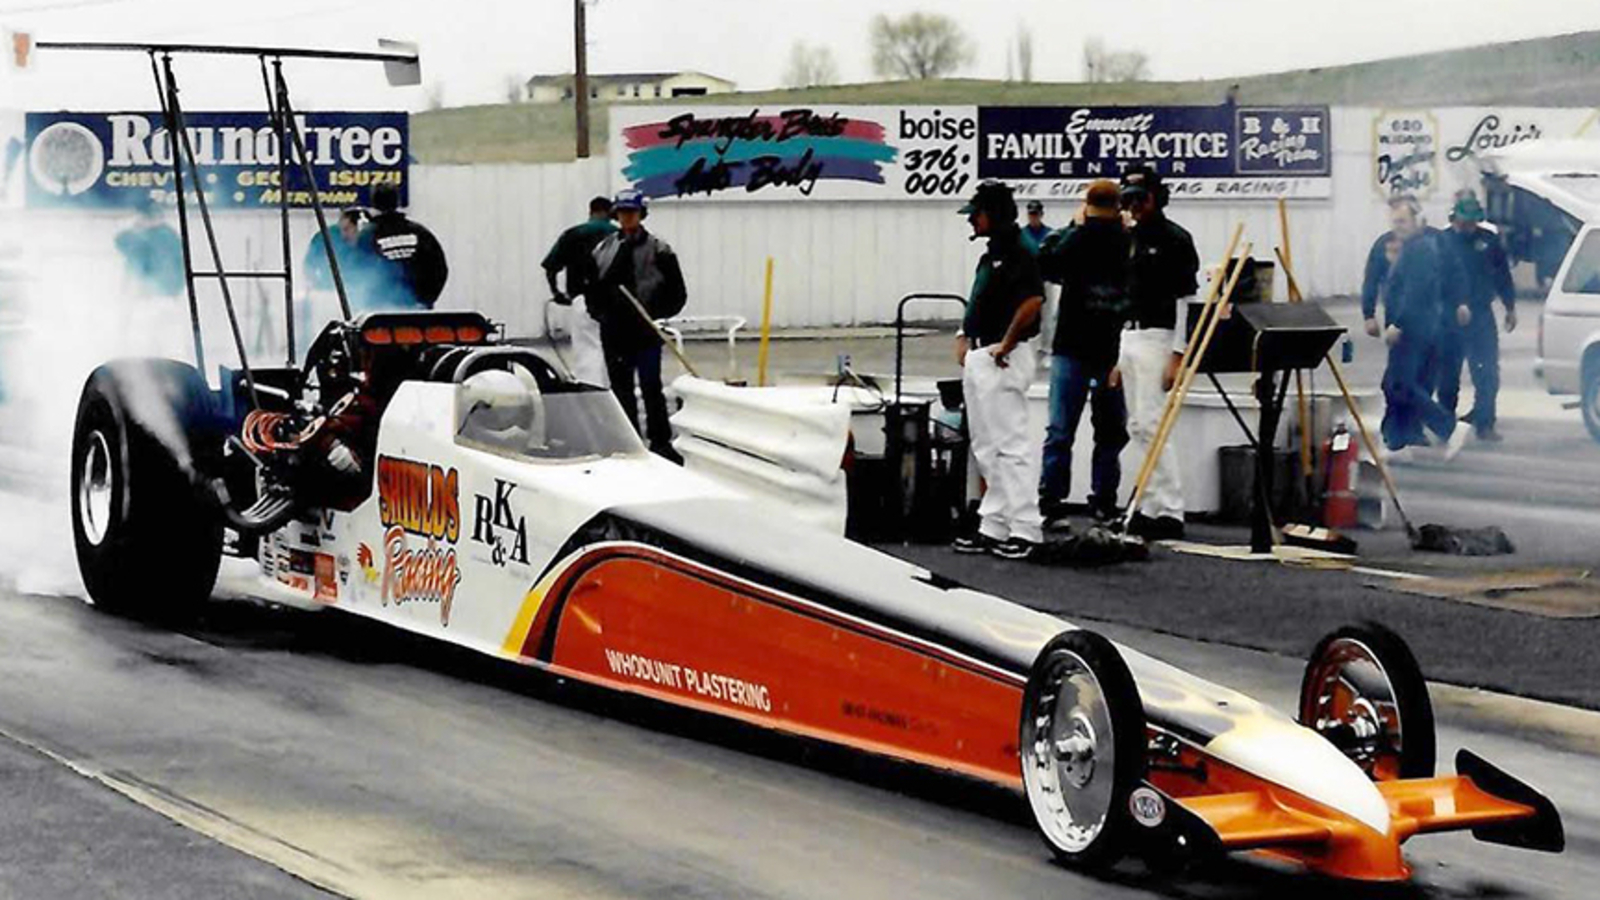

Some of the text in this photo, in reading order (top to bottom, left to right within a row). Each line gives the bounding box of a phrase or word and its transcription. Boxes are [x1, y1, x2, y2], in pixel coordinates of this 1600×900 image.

[107, 114, 402, 166] Roundtree
[900, 109, 976, 140] boise
[1065, 109, 1154, 133] Emmett
[987, 133, 1228, 159] FAMILY PRACTICE
[329, 170, 402, 186] ISUZU
[746, 148, 824, 195] Body
[905, 168, 969, 195] 0061
[378, 453, 460, 545] SHIELDS
[380, 524, 462, 628] Racing
[605, 648, 772, 712] WHODUNIT PLASTERING
